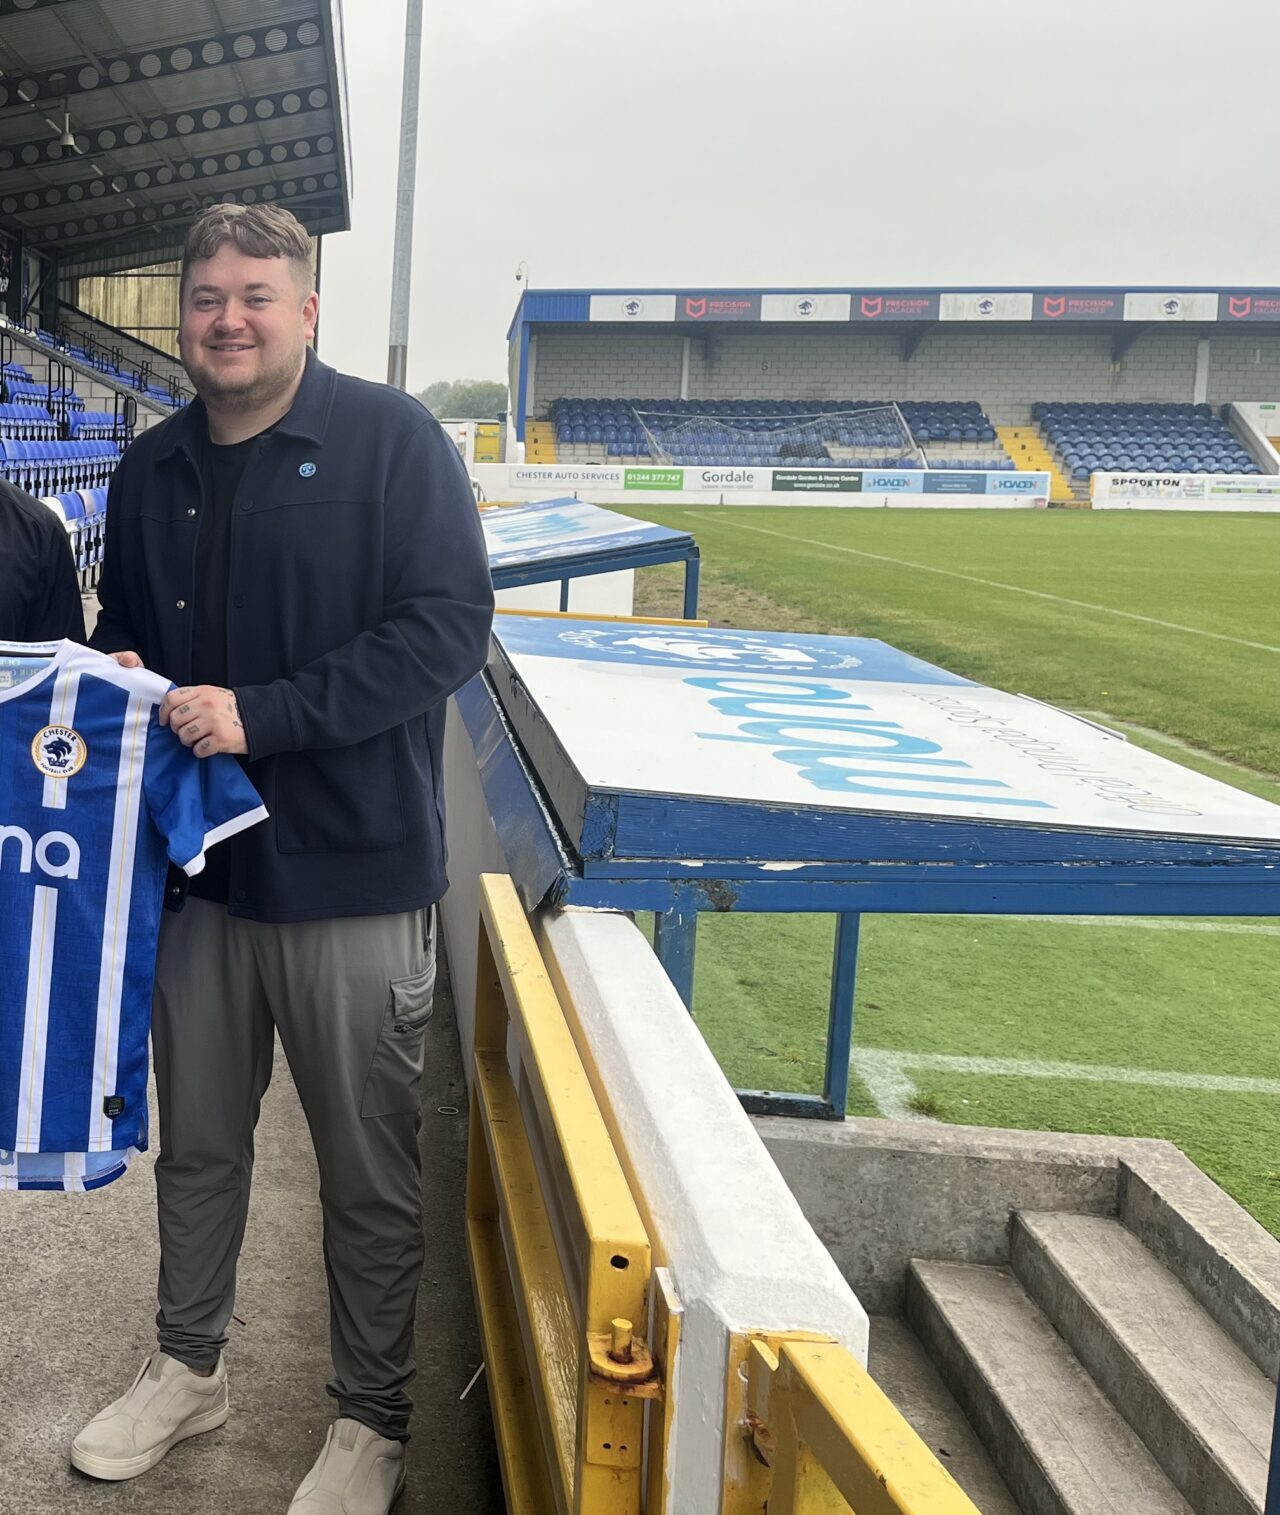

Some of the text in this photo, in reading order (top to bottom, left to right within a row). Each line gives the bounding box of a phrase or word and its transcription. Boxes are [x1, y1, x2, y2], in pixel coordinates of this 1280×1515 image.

[516, 471, 620, 481] CHESTER AUTO SERVICES
[627, 473, 650, 481] 01244
[702, 471, 754, 482] Gordale
[43, 729, 77, 742] CHESTER
[681, 677, 1058, 809] mbna
